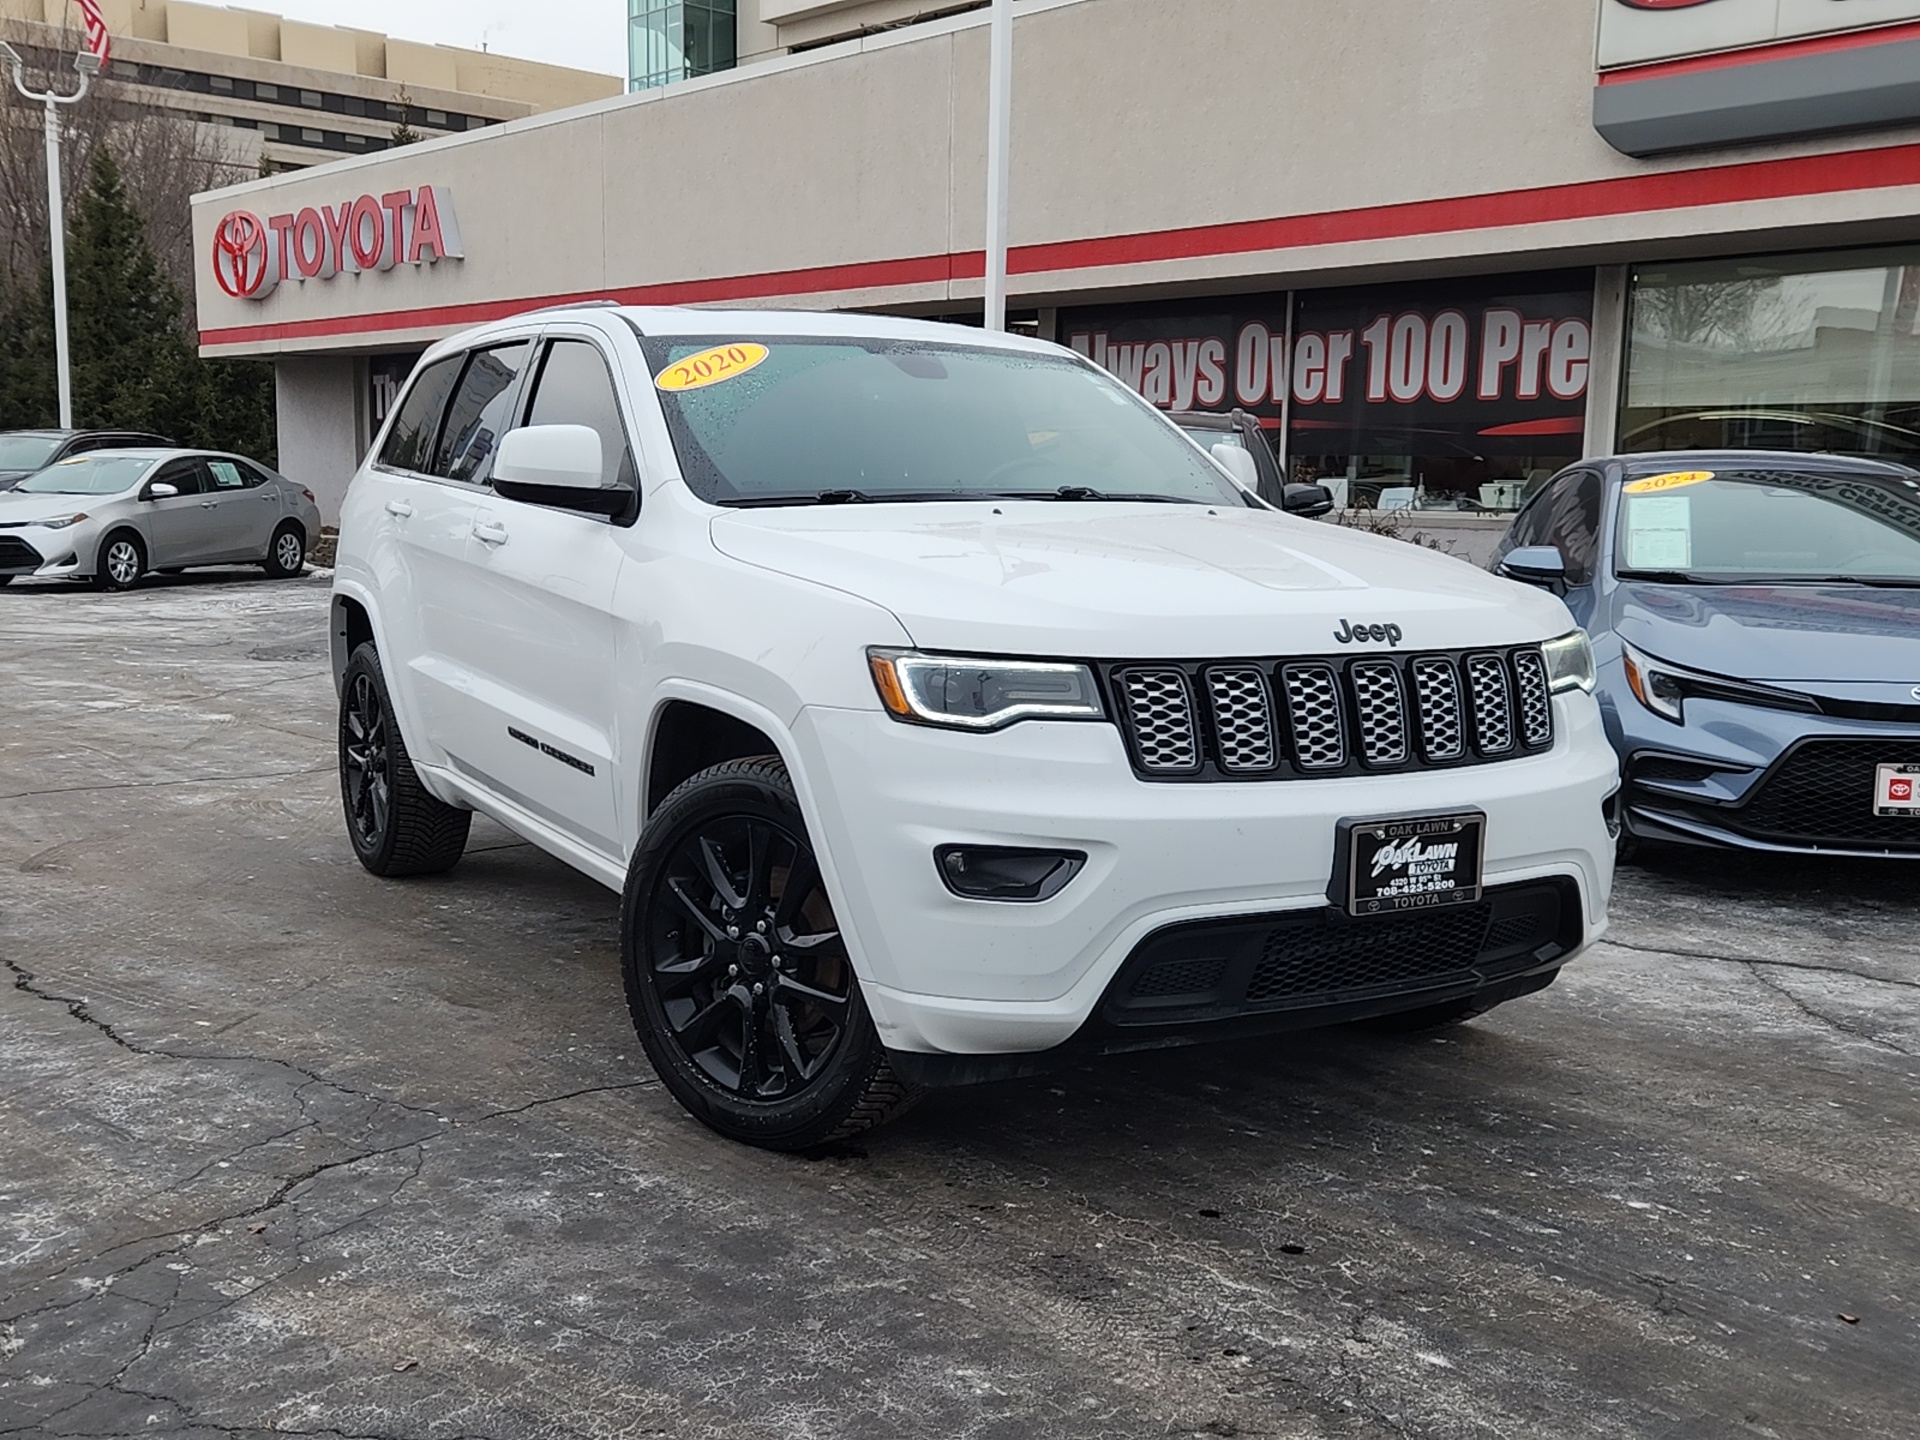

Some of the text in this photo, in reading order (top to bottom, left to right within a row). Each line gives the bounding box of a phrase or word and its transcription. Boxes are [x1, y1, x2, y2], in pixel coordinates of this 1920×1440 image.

[269, 185, 447, 280] TOYOTA
[674, 346, 748, 386] 2020
[1237, 322, 1352, 403] Over
[1362, 311, 1467, 401] 100
[1478, 309, 1590, 399] Pre
[373, 373, 403, 419] Th
[1333, 618, 1403, 648] Jeep
[1389, 821, 1449, 836] OAK LAWN
[1414, 860, 1450, 874] TOYOTA
[1376, 879, 1455, 897] 708-423-5200
[1393, 893, 1440, 909] TOYOTA
